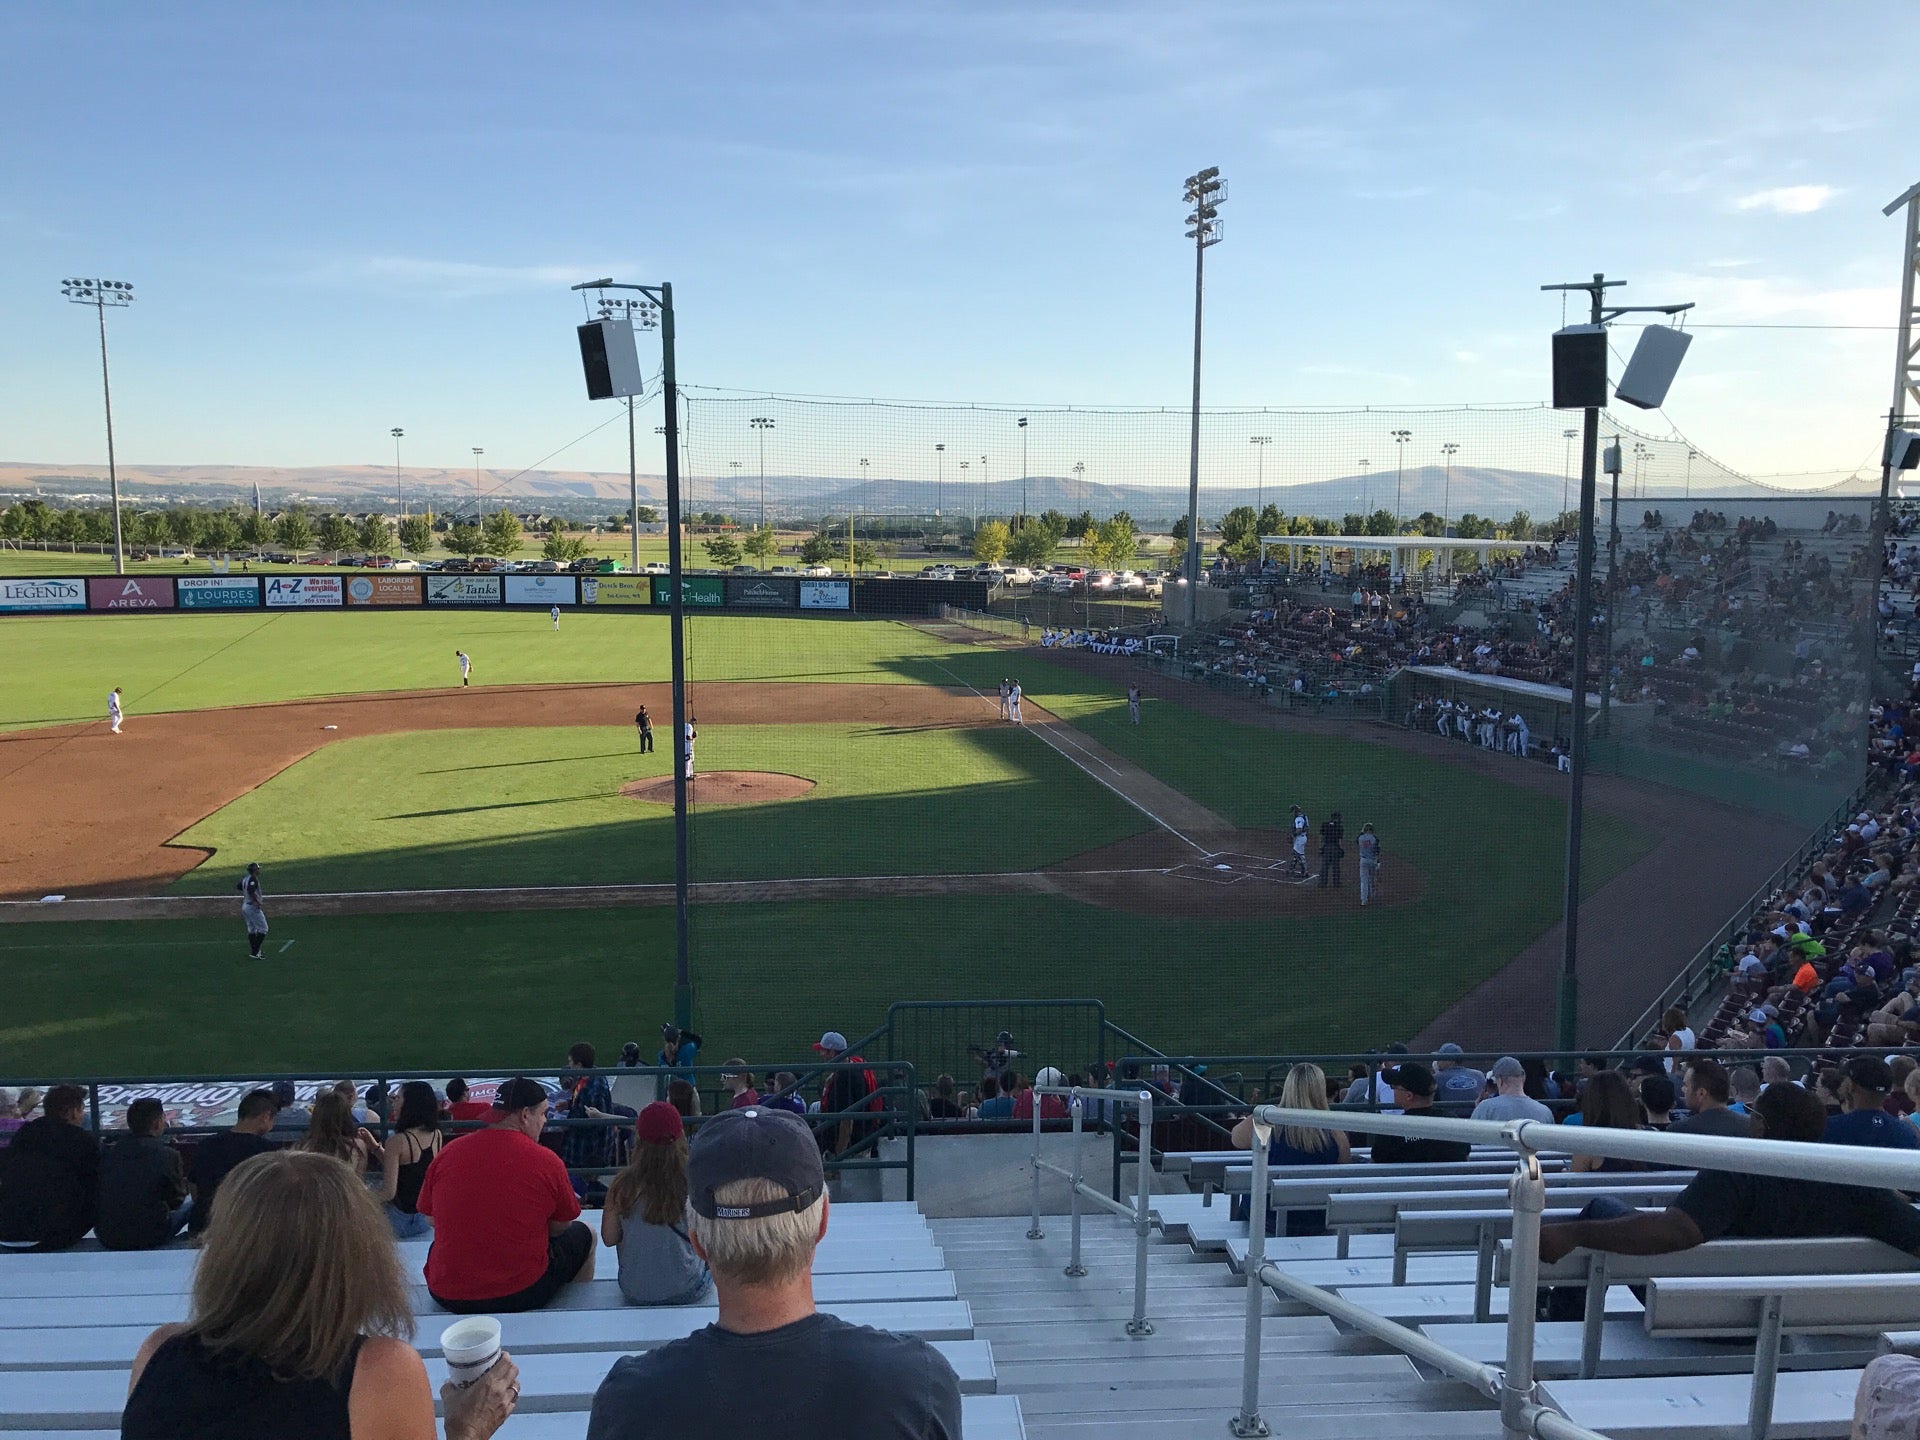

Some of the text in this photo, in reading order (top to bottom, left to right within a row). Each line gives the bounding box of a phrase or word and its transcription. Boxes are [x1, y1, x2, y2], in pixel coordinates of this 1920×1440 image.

[5, 584, 78, 598] LEGENDS
[268, 578, 303, 594] A Z
[465, 584, 498, 595] Tanks
[197, 590, 254, 599] LOURDES
[690, 592, 720, 603] Health
[108, 599, 157, 607] AREVA
[97, 1084, 241, 1107] Brewing
[716, 1207, 751, 1217] MARINERS
